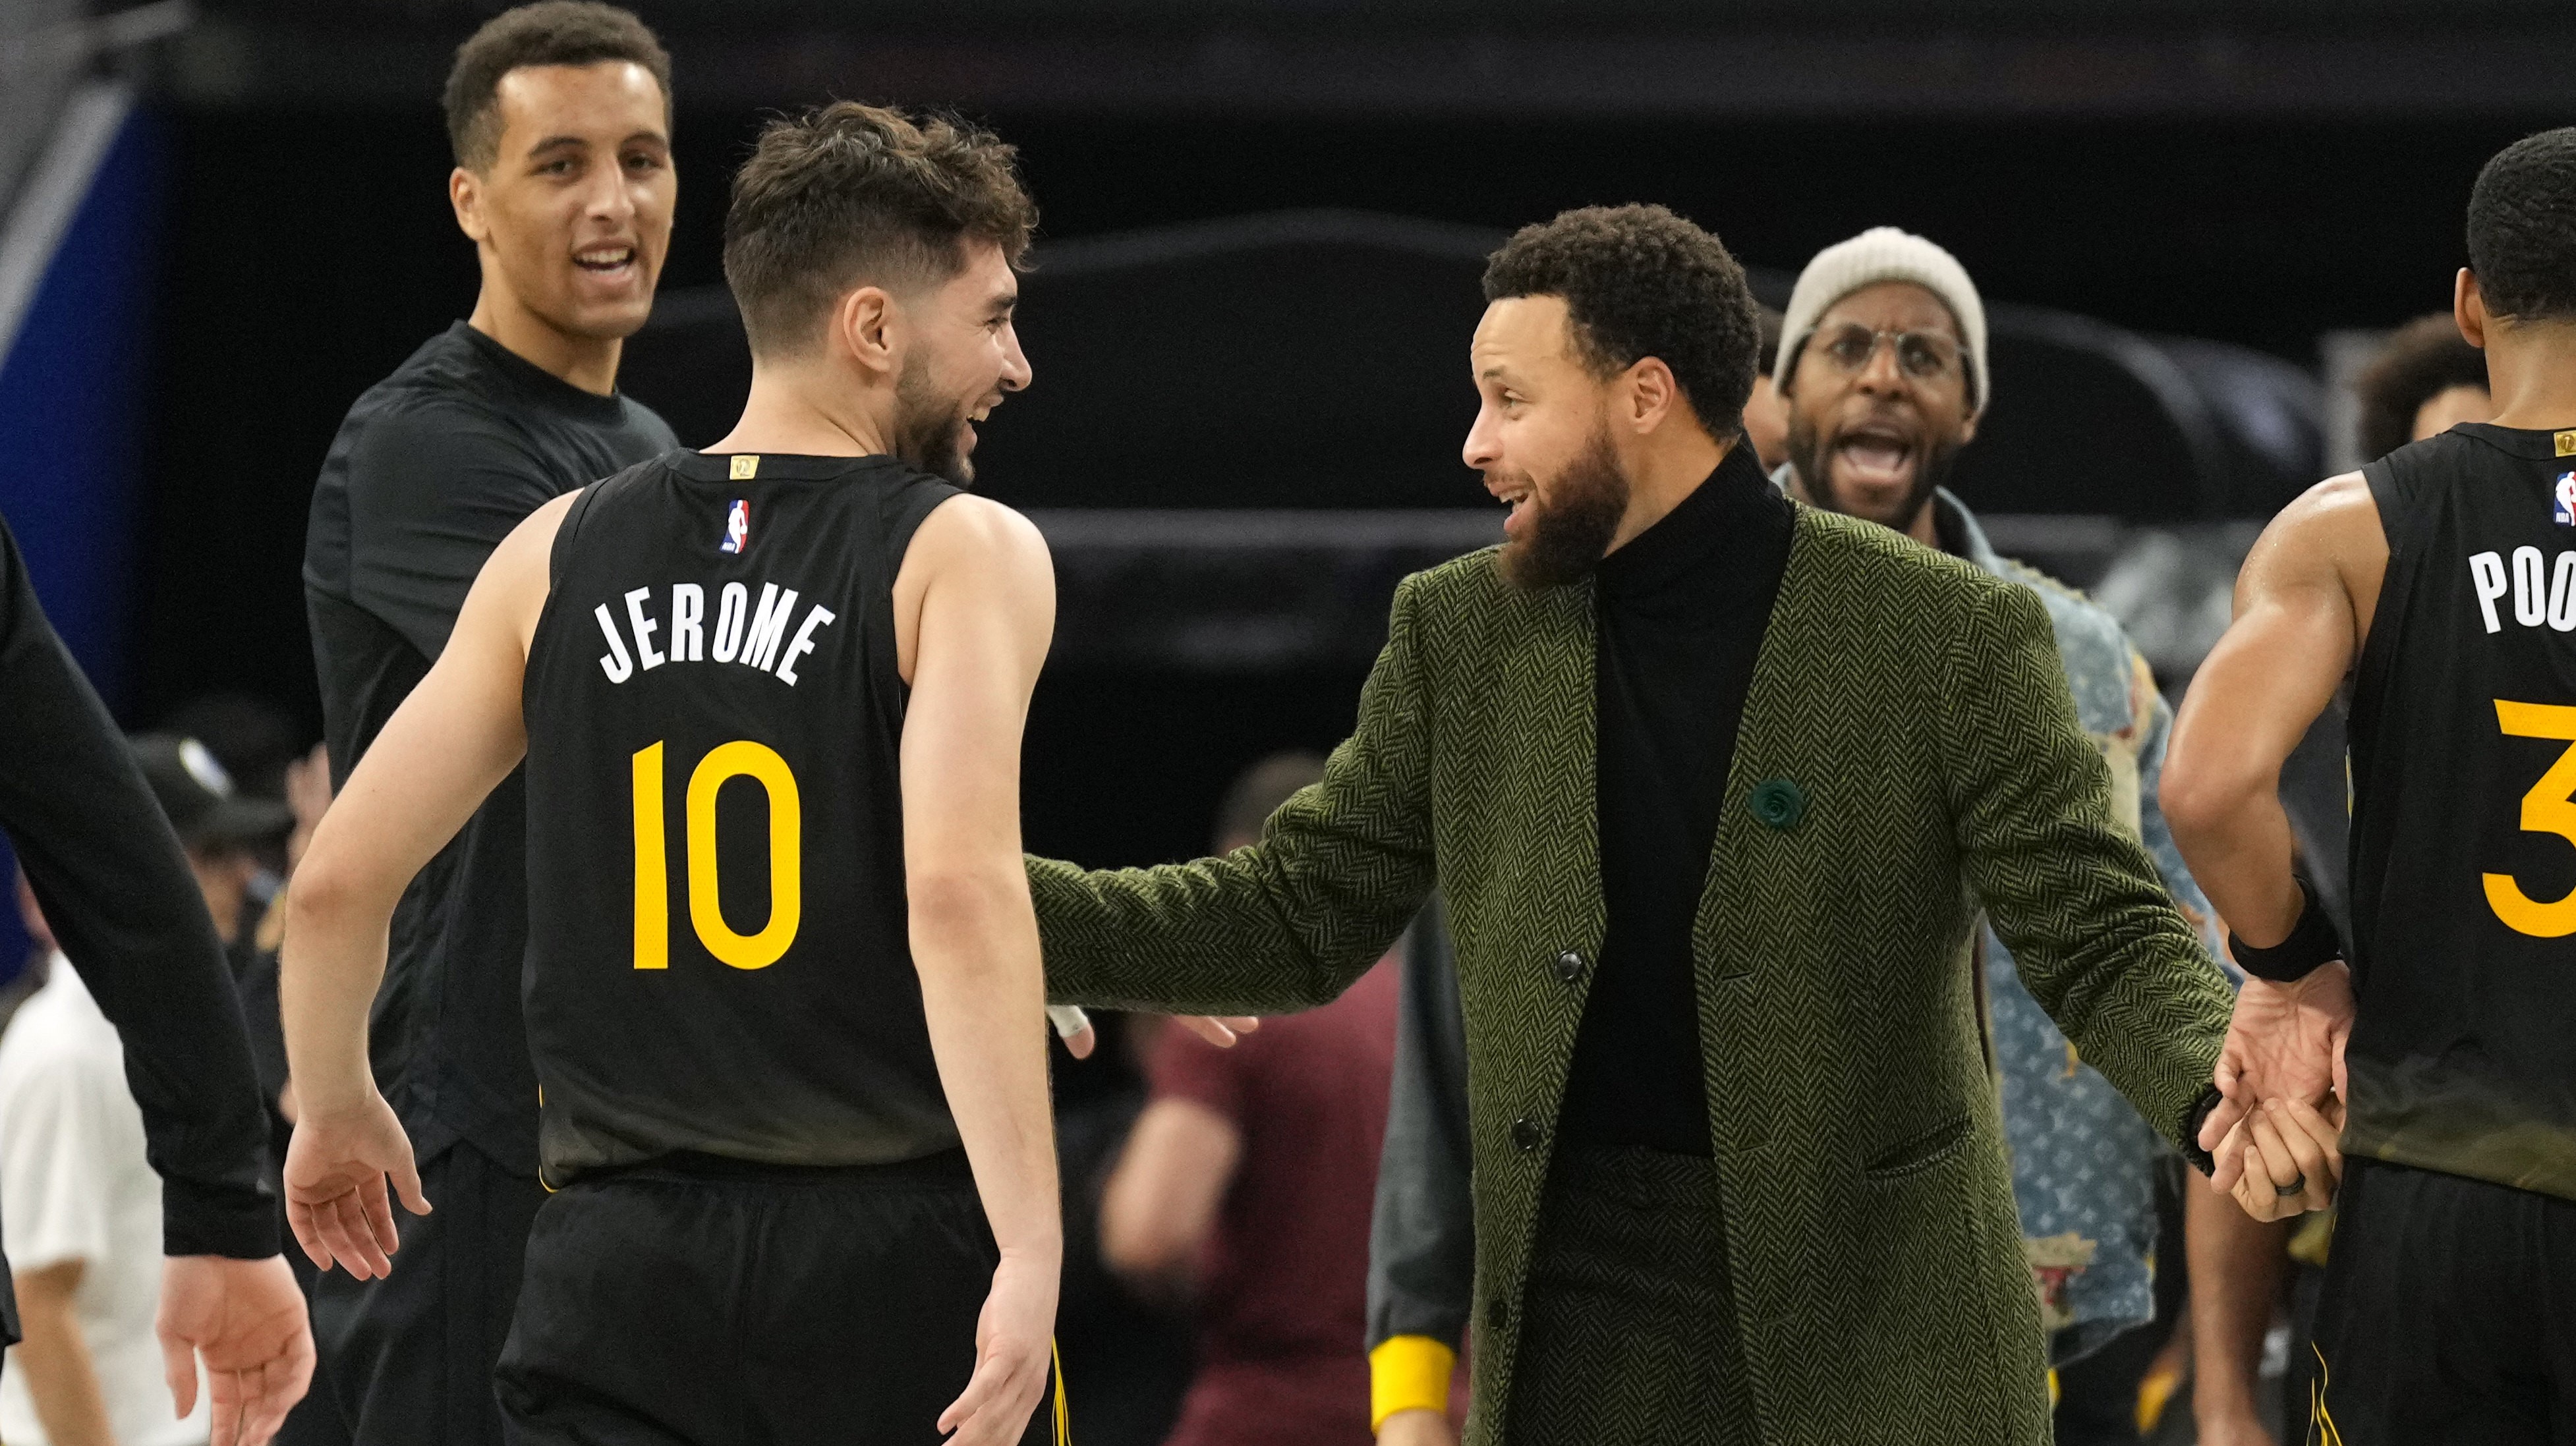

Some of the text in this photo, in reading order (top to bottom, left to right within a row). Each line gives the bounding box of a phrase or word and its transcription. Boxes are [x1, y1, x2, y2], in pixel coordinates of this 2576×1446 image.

[721, 542, 735, 551] NBA
[2556, 512, 2569, 523] NBA
[594, 581, 836, 688] JEROME
[632, 740, 801, 970] 10
[2482, 698, 2576, 938] 3
